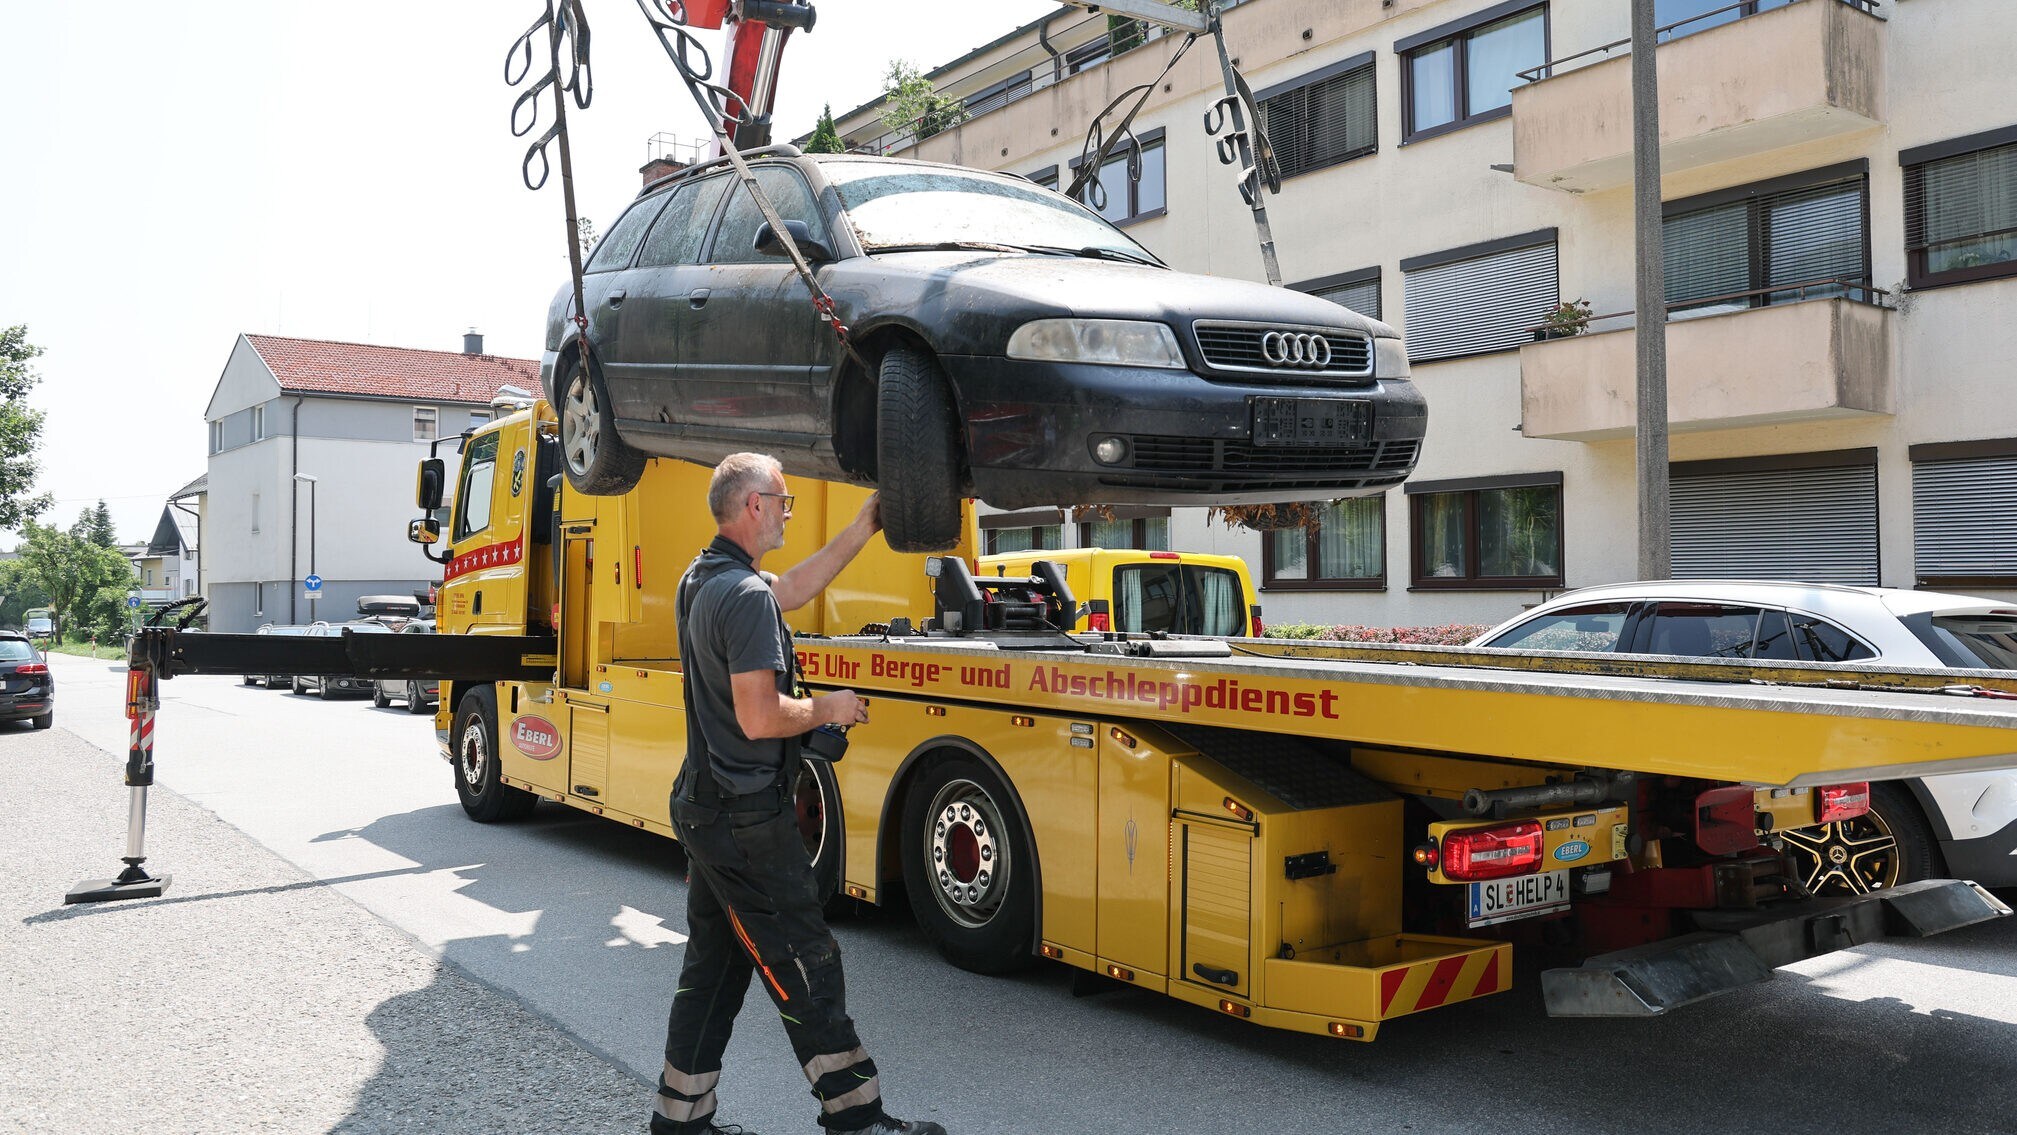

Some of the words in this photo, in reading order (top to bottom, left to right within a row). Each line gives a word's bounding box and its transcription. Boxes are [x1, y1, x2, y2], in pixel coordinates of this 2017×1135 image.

[825, 653, 861, 680] Uhr
[871, 653, 953, 688] Berge-
[960, 663, 1011, 689] und
[1028, 665, 1340, 720] Abschleppdienst
[516, 722, 553, 747] EBERL
[1561, 844, 1582, 856] EBERL
[1486, 883, 1504, 911] SL
[1516, 875, 1552, 906] HELP
[1556, 873, 1564, 899] 4
